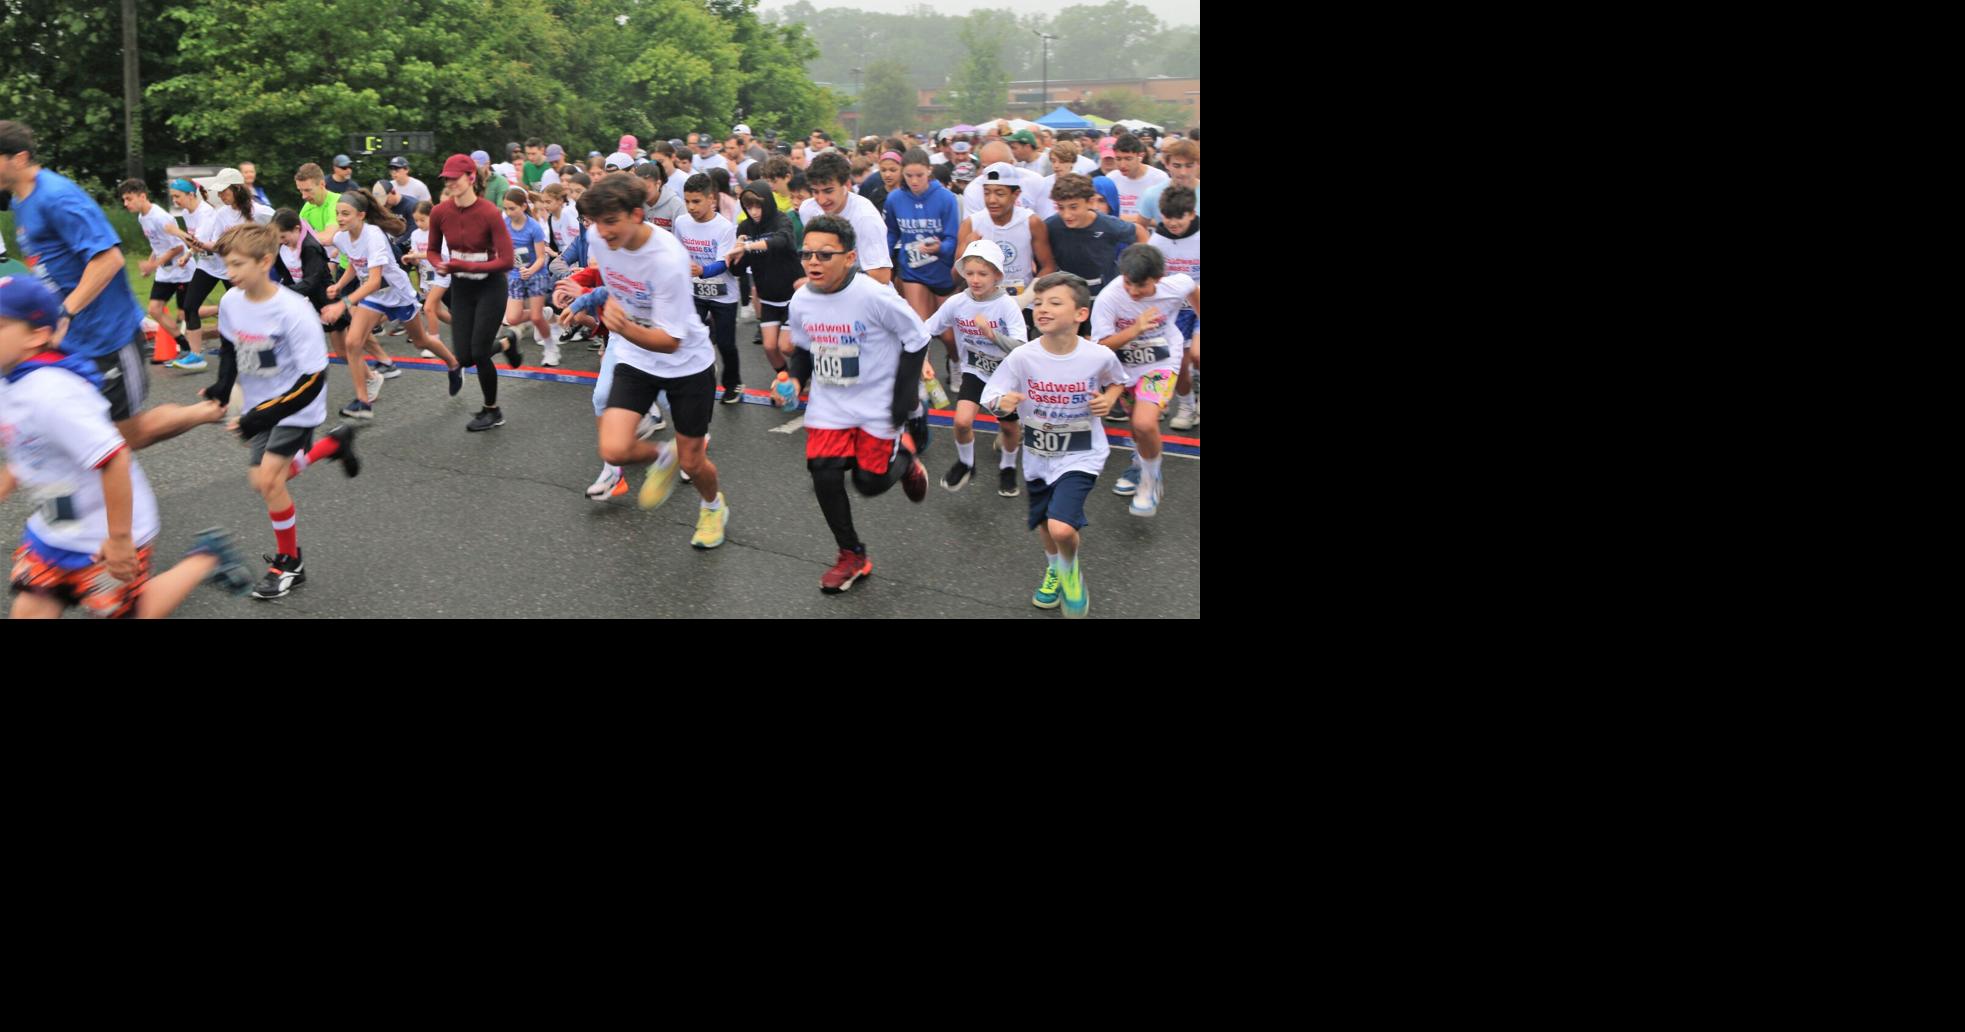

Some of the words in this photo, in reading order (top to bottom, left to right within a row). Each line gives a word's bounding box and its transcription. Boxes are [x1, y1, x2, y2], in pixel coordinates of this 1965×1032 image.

[697, 283, 718, 296] 336
[955, 317, 998, 328] Caldll
[1123, 347, 1156, 364] 396
[1027, 378, 1086, 393] Caldwell
[1028, 389, 1070, 405] Cassic
[1071, 394, 1088, 404] 5K
[1032, 429, 1072, 452] 307
